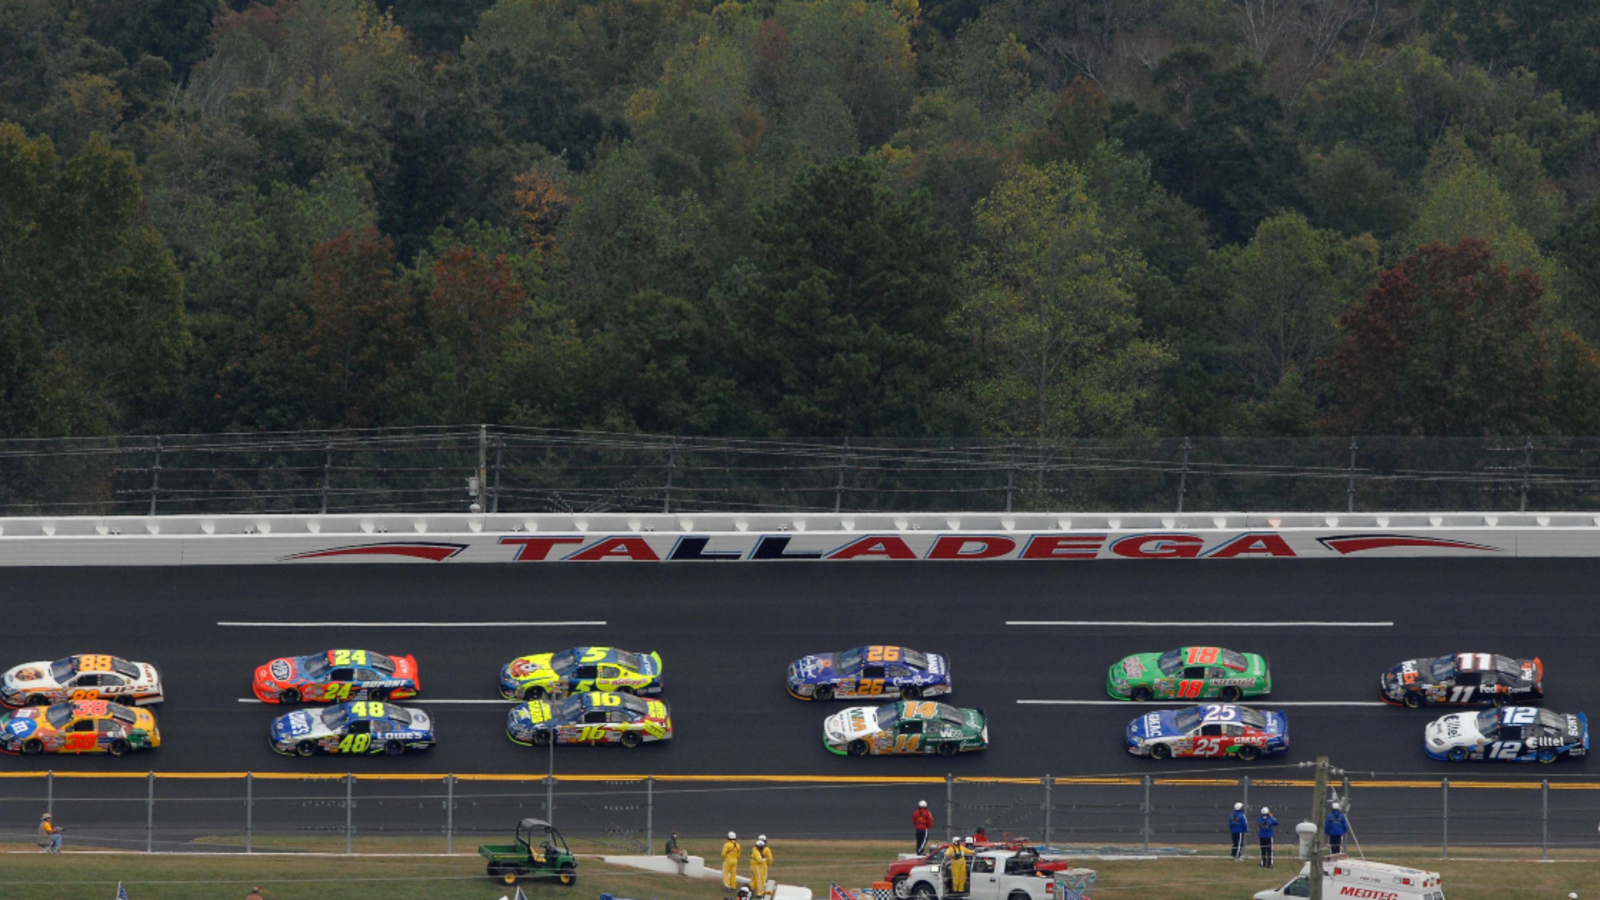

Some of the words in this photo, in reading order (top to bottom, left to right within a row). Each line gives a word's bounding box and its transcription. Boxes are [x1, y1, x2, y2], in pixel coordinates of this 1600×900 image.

[497, 531, 1297, 561] TALLADEGA
[335, 650, 367, 665] 24
[580, 647, 612, 662] 5
[867, 646, 900, 662] 26
[1186, 647, 1220, 664] 18
[1457, 653, 1493, 670] 11
[79, 655, 113, 671] 88
[1402, 659, 1419, 685] FedEx
[105, 685, 149, 694] UPS
[324, 683, 352, 699] 24
[574, 680, 595, 694] 5
[857, 679, 885, 695] 26
[1176, 680, 1204, 698] 18
[1450, 686, 1476, 702] 11
[1480, 684, 1508, 693] FedEx
[591, 691, 621, 707] 16
[73, 700, 108, 716] 38
[351, 701, 385, 717] 48
[904, 701, 938, 719] 14
[1203, 705, 1236, 720] 25
[1503, 707, 1538, 724] 12
[578, 725, 606, 741] 16
[1566, 714, 1578, 737] SONY
[65, 734, 97, 750] 38
[339, 733, 368, 753] 48
[894, 735, 922, 752] 14
[1193, 739, 1222, 756] 25
[1233, 736, 1263, 745] GMAC
[1489, 741, 1523, 758] 12
[1340, 886, 1399, 900] MEDTEC
